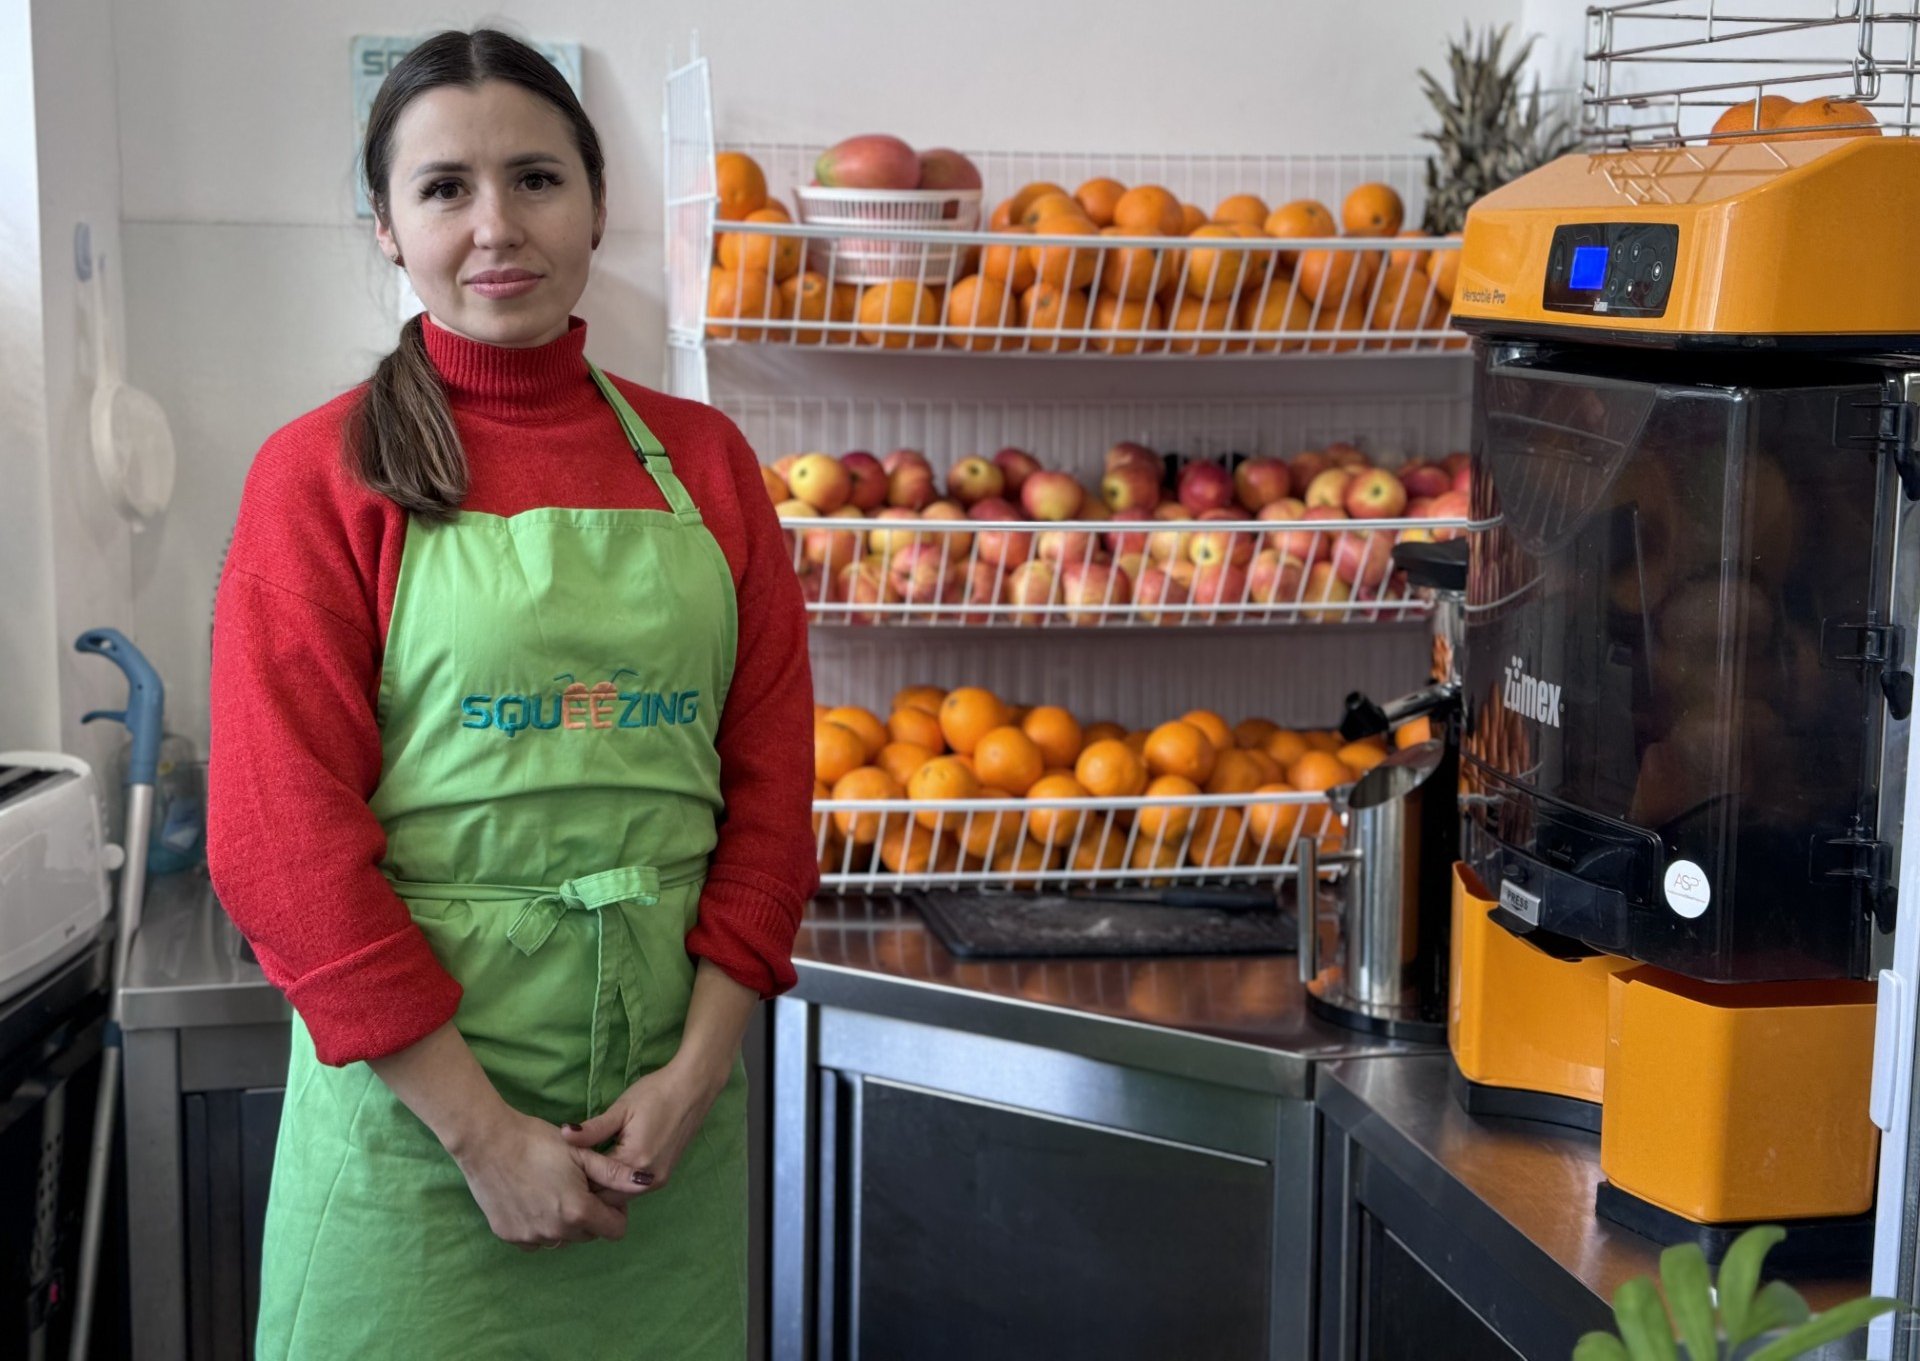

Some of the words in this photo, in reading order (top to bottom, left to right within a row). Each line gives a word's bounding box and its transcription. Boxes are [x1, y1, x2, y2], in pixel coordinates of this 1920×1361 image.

[1492, 289, 1506, 305] Pro
[462, 682, 699, 738] SQUEEZING
[1506, 889, 1529, 911] PRESS
